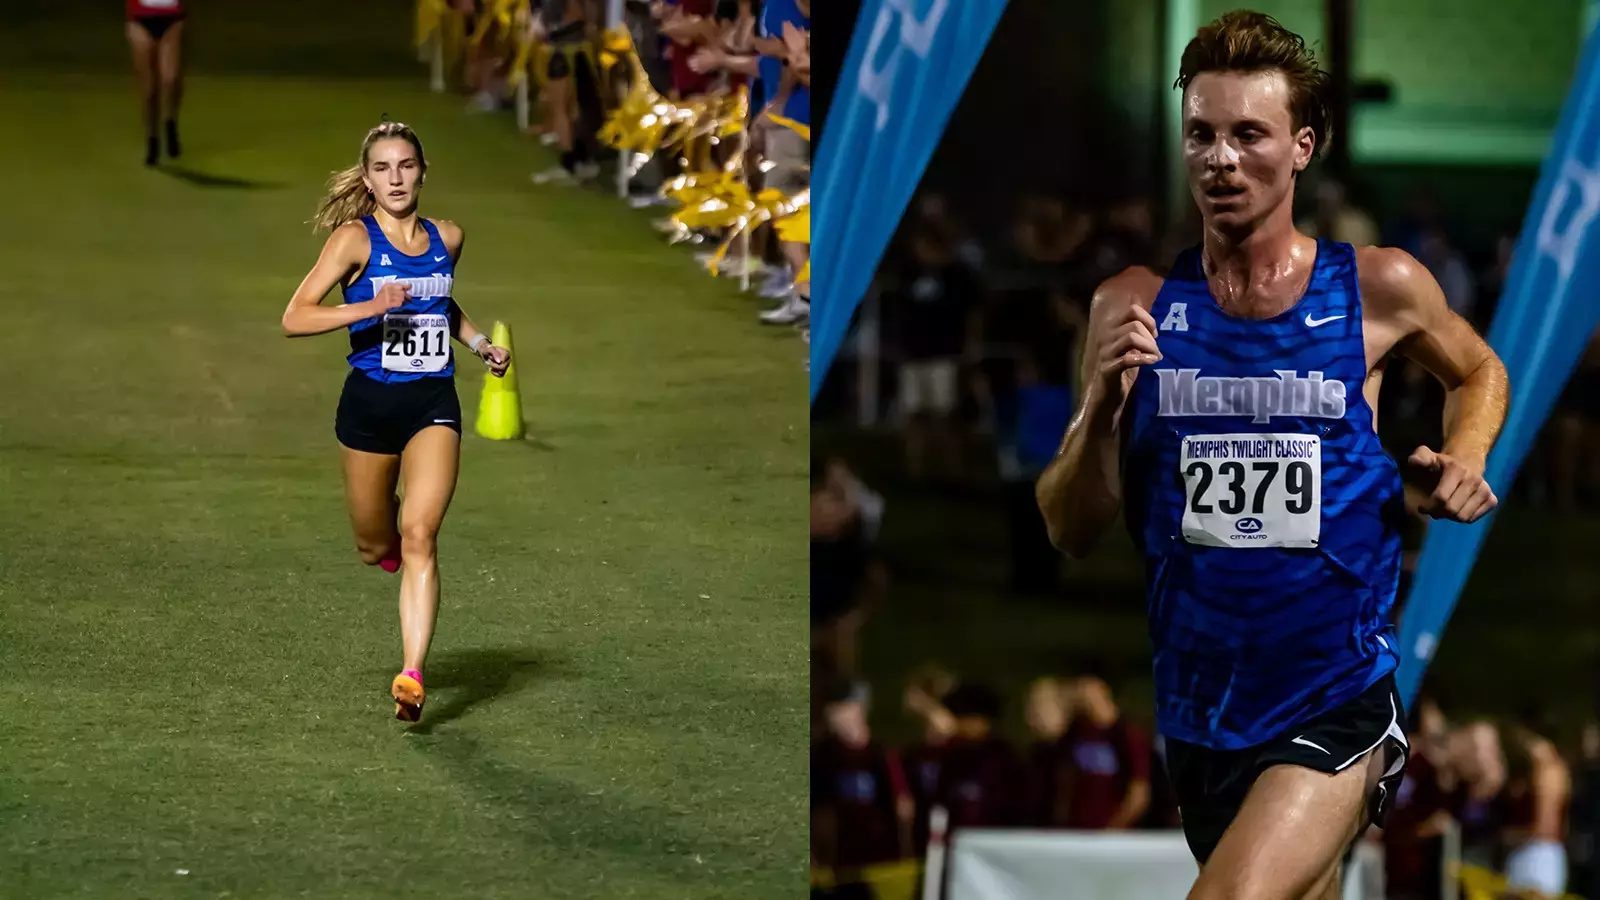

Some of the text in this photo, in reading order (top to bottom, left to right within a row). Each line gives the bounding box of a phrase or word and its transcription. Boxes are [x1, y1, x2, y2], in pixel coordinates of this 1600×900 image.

[380, 254, 392, 266] A
[1159, 302, 1189, 331] A
[385, 329, 446, 357] 2611
[1153, 368, 1347, 424] Memphis
[1186, 440, 1313, 459] MEMPHIS TWILIGHT CLASSIC
[1186, 461, 1313, 515] 2379
[1236, 519, 1260, 531] CA
